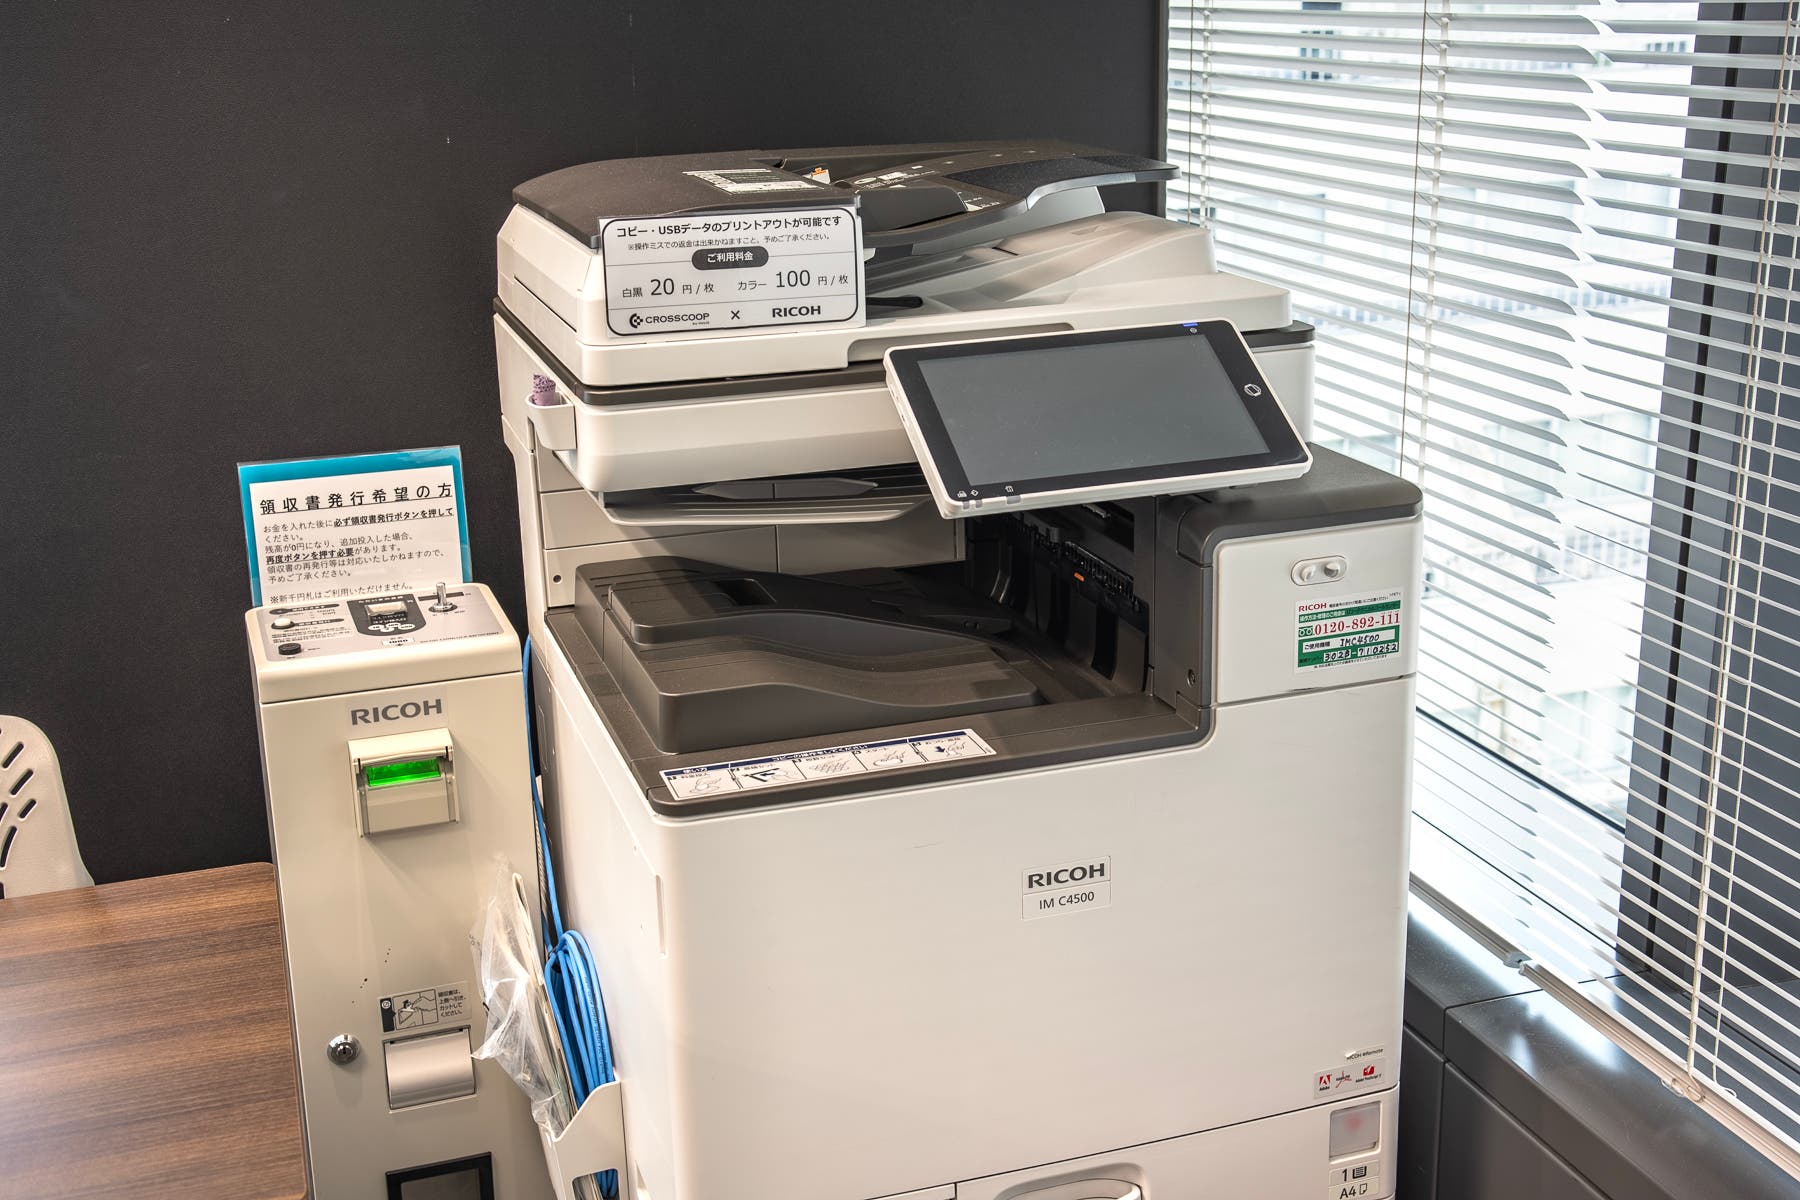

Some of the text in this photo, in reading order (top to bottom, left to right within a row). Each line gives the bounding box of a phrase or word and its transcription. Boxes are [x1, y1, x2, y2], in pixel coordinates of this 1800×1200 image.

[617, 216, 842, 238] コピー・USBデータのプリントアウトが可能です
[707, 252, 754, 263] ご利用料金
[622, 287, 643, 298] 白黒
[650, 278, 675, 296] 20
[738, 281, 767, 291] カラー
[776, 270, 811, 288] 100
[645, 313, 710, 324] CROSSCOOP
[772, 305, 821, 318] RICOH
[259, 483, 453, 514] 領収書発行希望の方
[1299, 603, 1327, 612] RICOH
[1314, 612, 1400, 635] 0120-892-111
[351, 699, 442, 726] RICOH
[1028, 863, 1104, 888] RICOH
[1040, 892, 1095, 909] IM C4500
[1342, 1168, 1348, 1182] 1
[1340, 1186, 1356, 1200] A4
